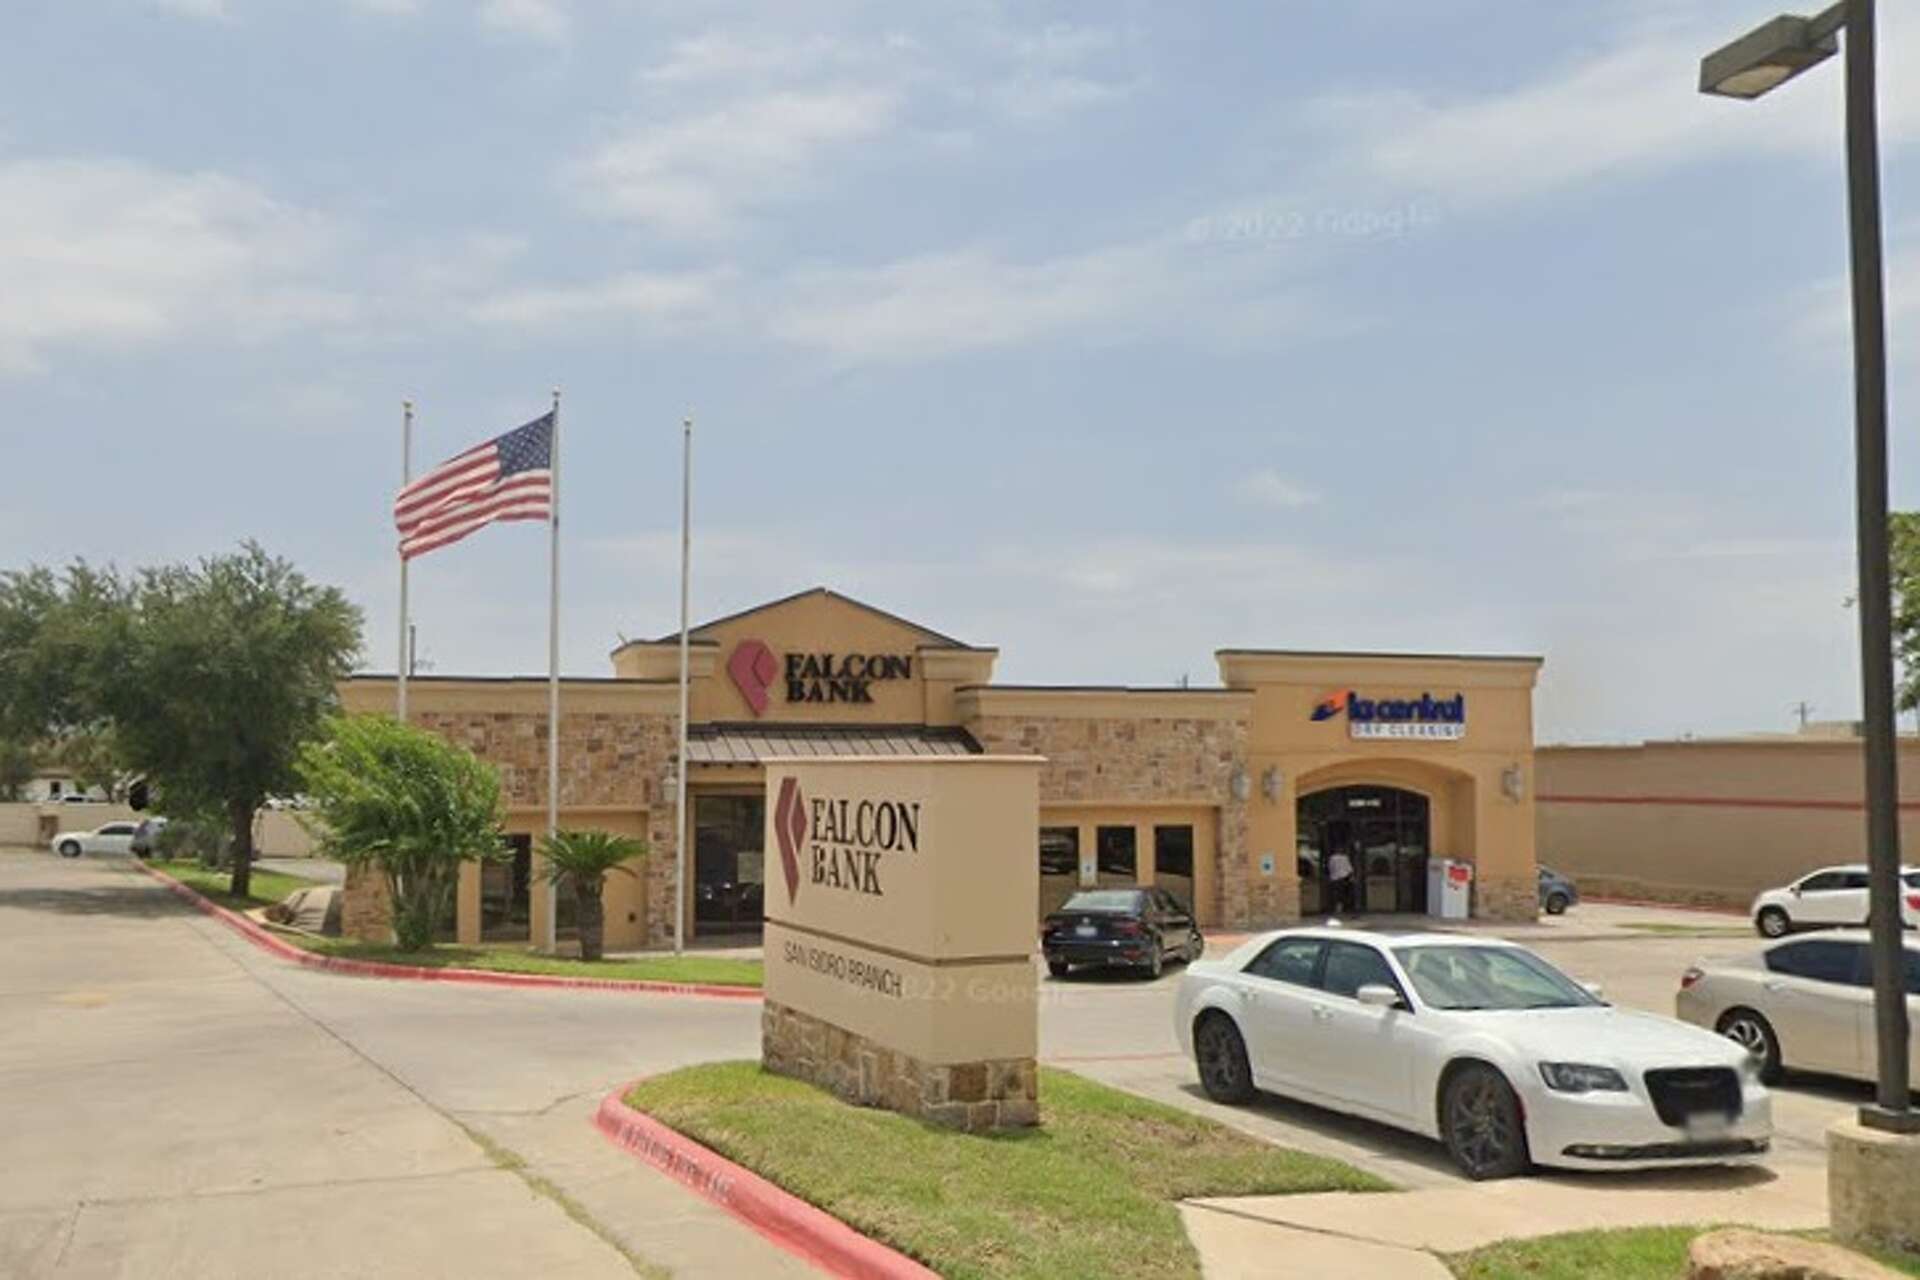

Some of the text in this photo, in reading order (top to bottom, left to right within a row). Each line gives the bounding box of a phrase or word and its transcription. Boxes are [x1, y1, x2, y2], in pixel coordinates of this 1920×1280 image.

[784, 654, 913, 679] FALCON
[785, 680, 874, 703] BANK
[810, 797, 921, 852] FALCON
[811, 844, 884, 896] BANK
[783, 940, 807, 966] SAN
[848, 958, 903, 998] BRANCH
